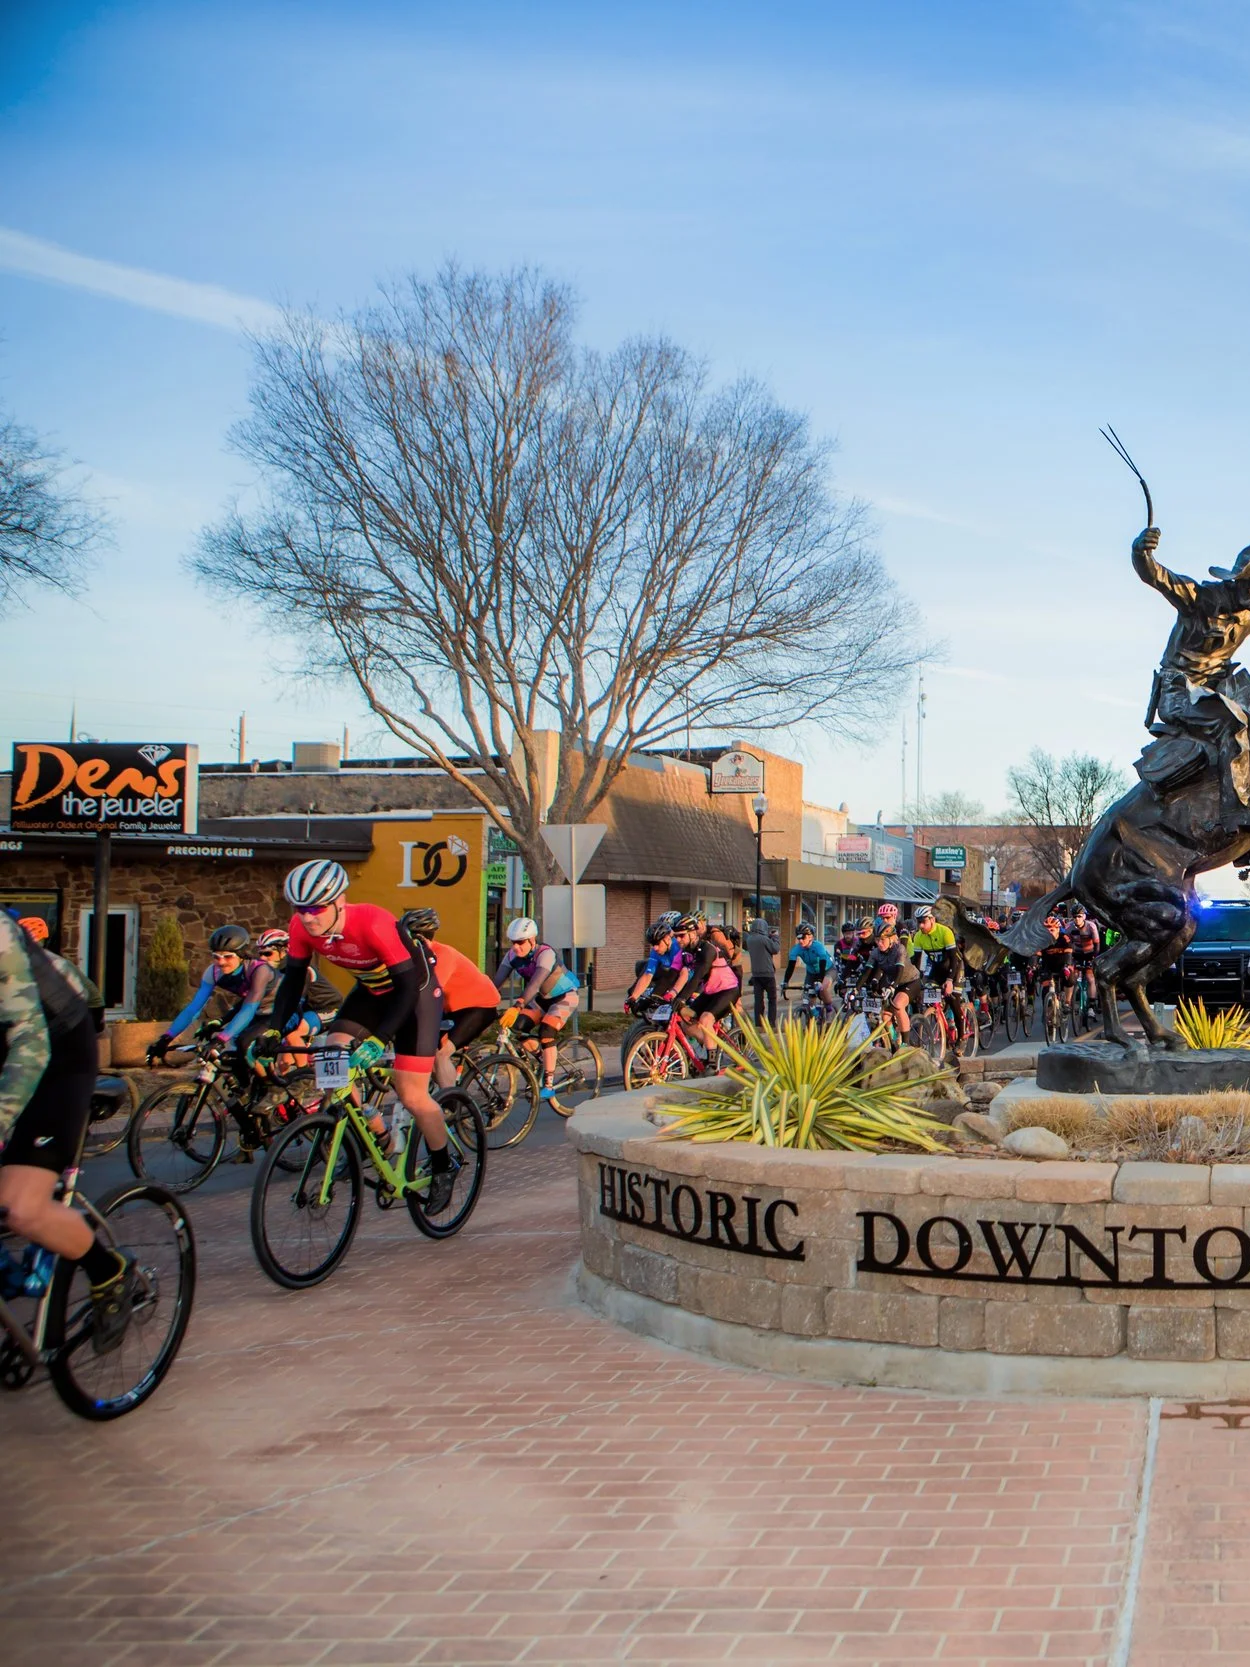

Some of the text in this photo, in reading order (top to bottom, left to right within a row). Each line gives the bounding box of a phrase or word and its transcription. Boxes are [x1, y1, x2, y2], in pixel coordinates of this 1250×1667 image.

[62, 791, 183, 822] the jeweler
[56, 820, 83, 830] Oldest
[85, 820, 118, 832] Original
[119, 821, 147, 833] Family
[148, 822, 182, 831] Jeweler
[166, 846, 254, 858] PRECIOUS GEMS
[324, 1061, 340, 1076] 431
[598, 1163, 806, 1262] HISTORIC
